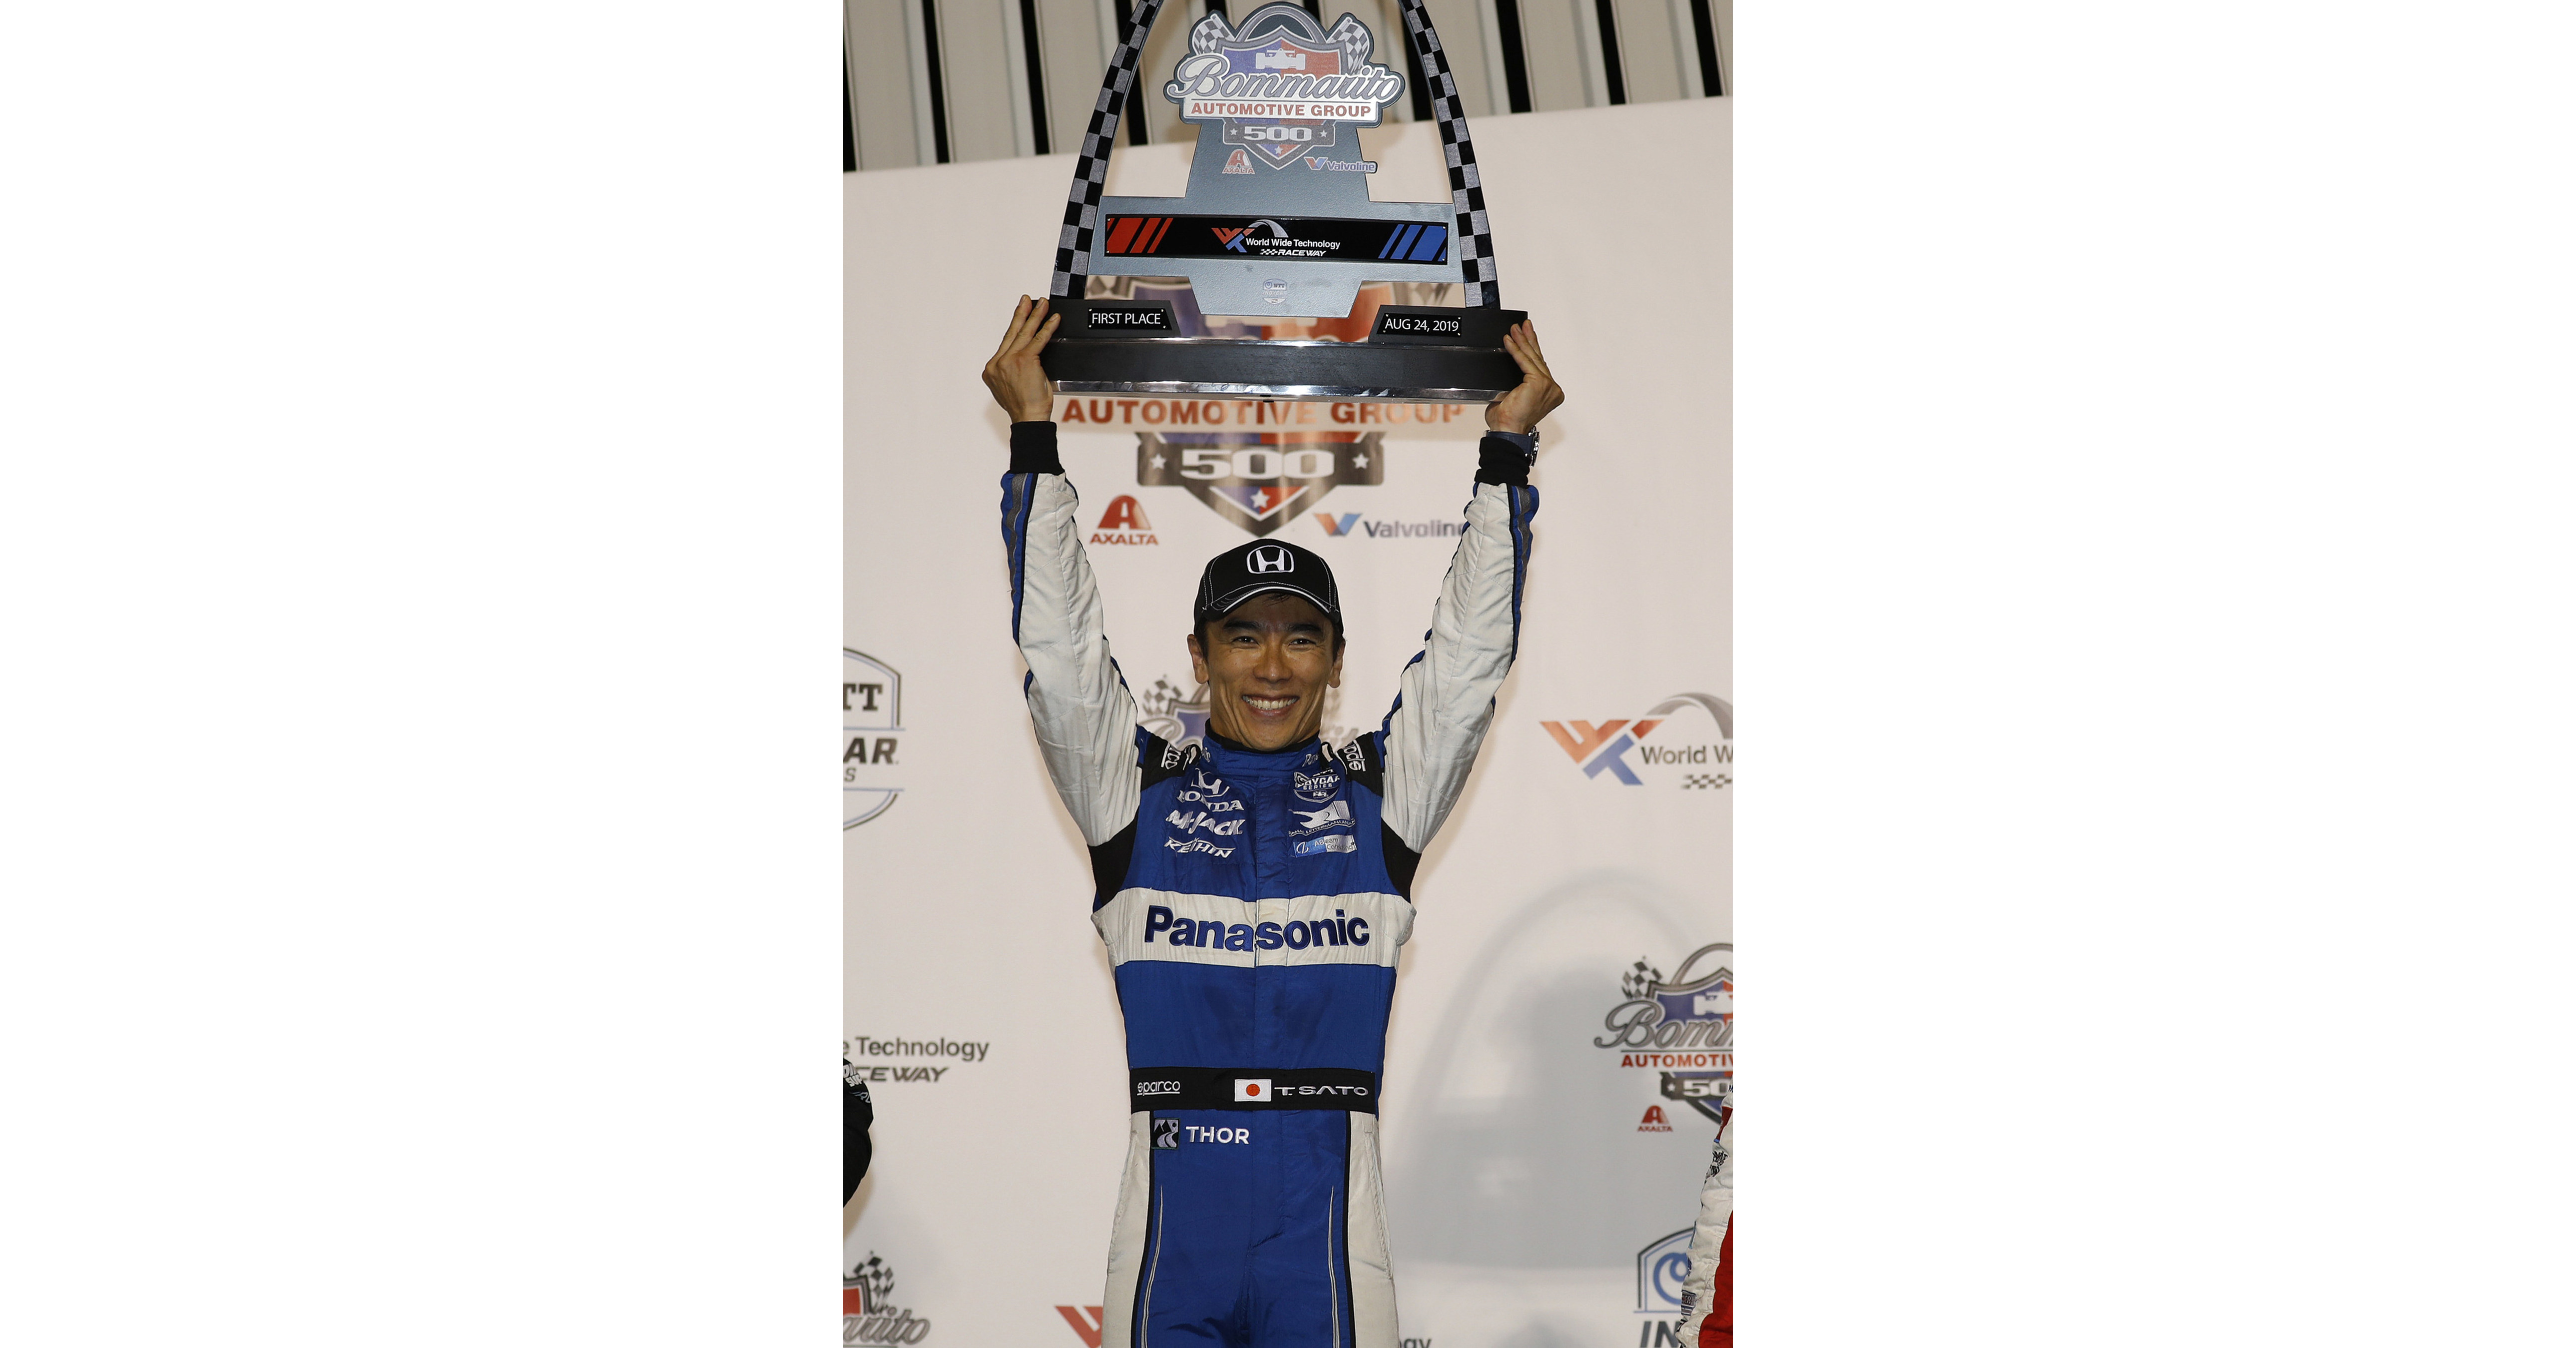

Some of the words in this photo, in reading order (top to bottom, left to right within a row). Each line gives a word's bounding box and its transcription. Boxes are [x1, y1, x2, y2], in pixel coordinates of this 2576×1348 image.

[1167, 53, 1401, 102] Bommarito
[1191, 102, 1305, 116] AUTOMOTIVE
[1311, 104, 1371, 117] GROUP
[1243, 126, 1312, 141] 500
[1327, 161, 1375, 171] Valvoline
[1246, 238, 1269, 246] World
[1271, 238, 1292, 247] Wide
[1293, 239, 1341, 250] Technology
[1092, 313, 1122, 325] FIRST
[1125, 313, 1161, 325] PLACE
[1385, 318, 1411, 330] AUG
[1414, 319, 1430, 332] 24,
[1433, 320, 1459, 332] 2019
[1061, 399, 1317, 425] AUTOMOTIVE
[1331, 402, 1465, 425] GROUP
[1180, 448, 1335, 480] 500
[1090, 534, 1158, 545] AXALTA
[1640, 745, 1707, 765] World
[1144, 905, 1370, 952] Panasonic
[855, 1036, 990, 1062] Technology
[1137, 1081, 1181, 1096] sparco
[1185, 1126, 1249, 1145] THOR
